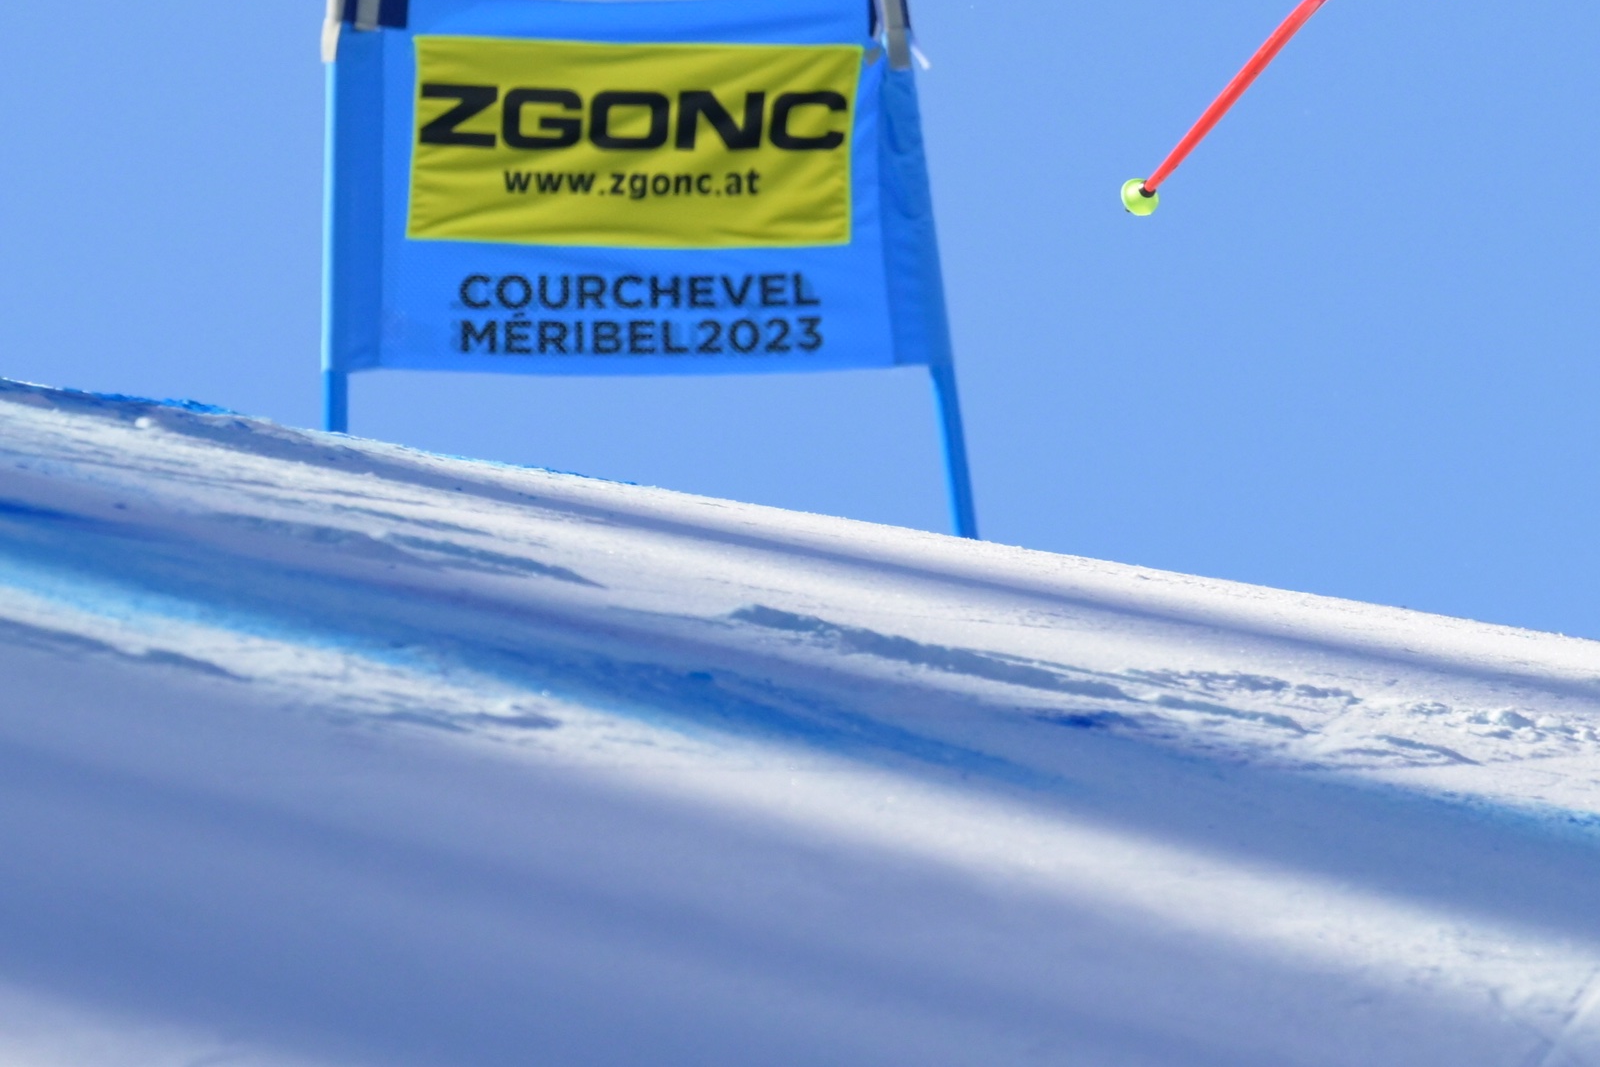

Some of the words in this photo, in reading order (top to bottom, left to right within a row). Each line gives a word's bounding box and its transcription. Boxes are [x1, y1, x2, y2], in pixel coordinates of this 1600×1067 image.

[418, 82, 848, 151] ZGONC
[503, 168, 760, 197] www.zgonc.at
[459, 273, 820, 310] COURCHEVEL
